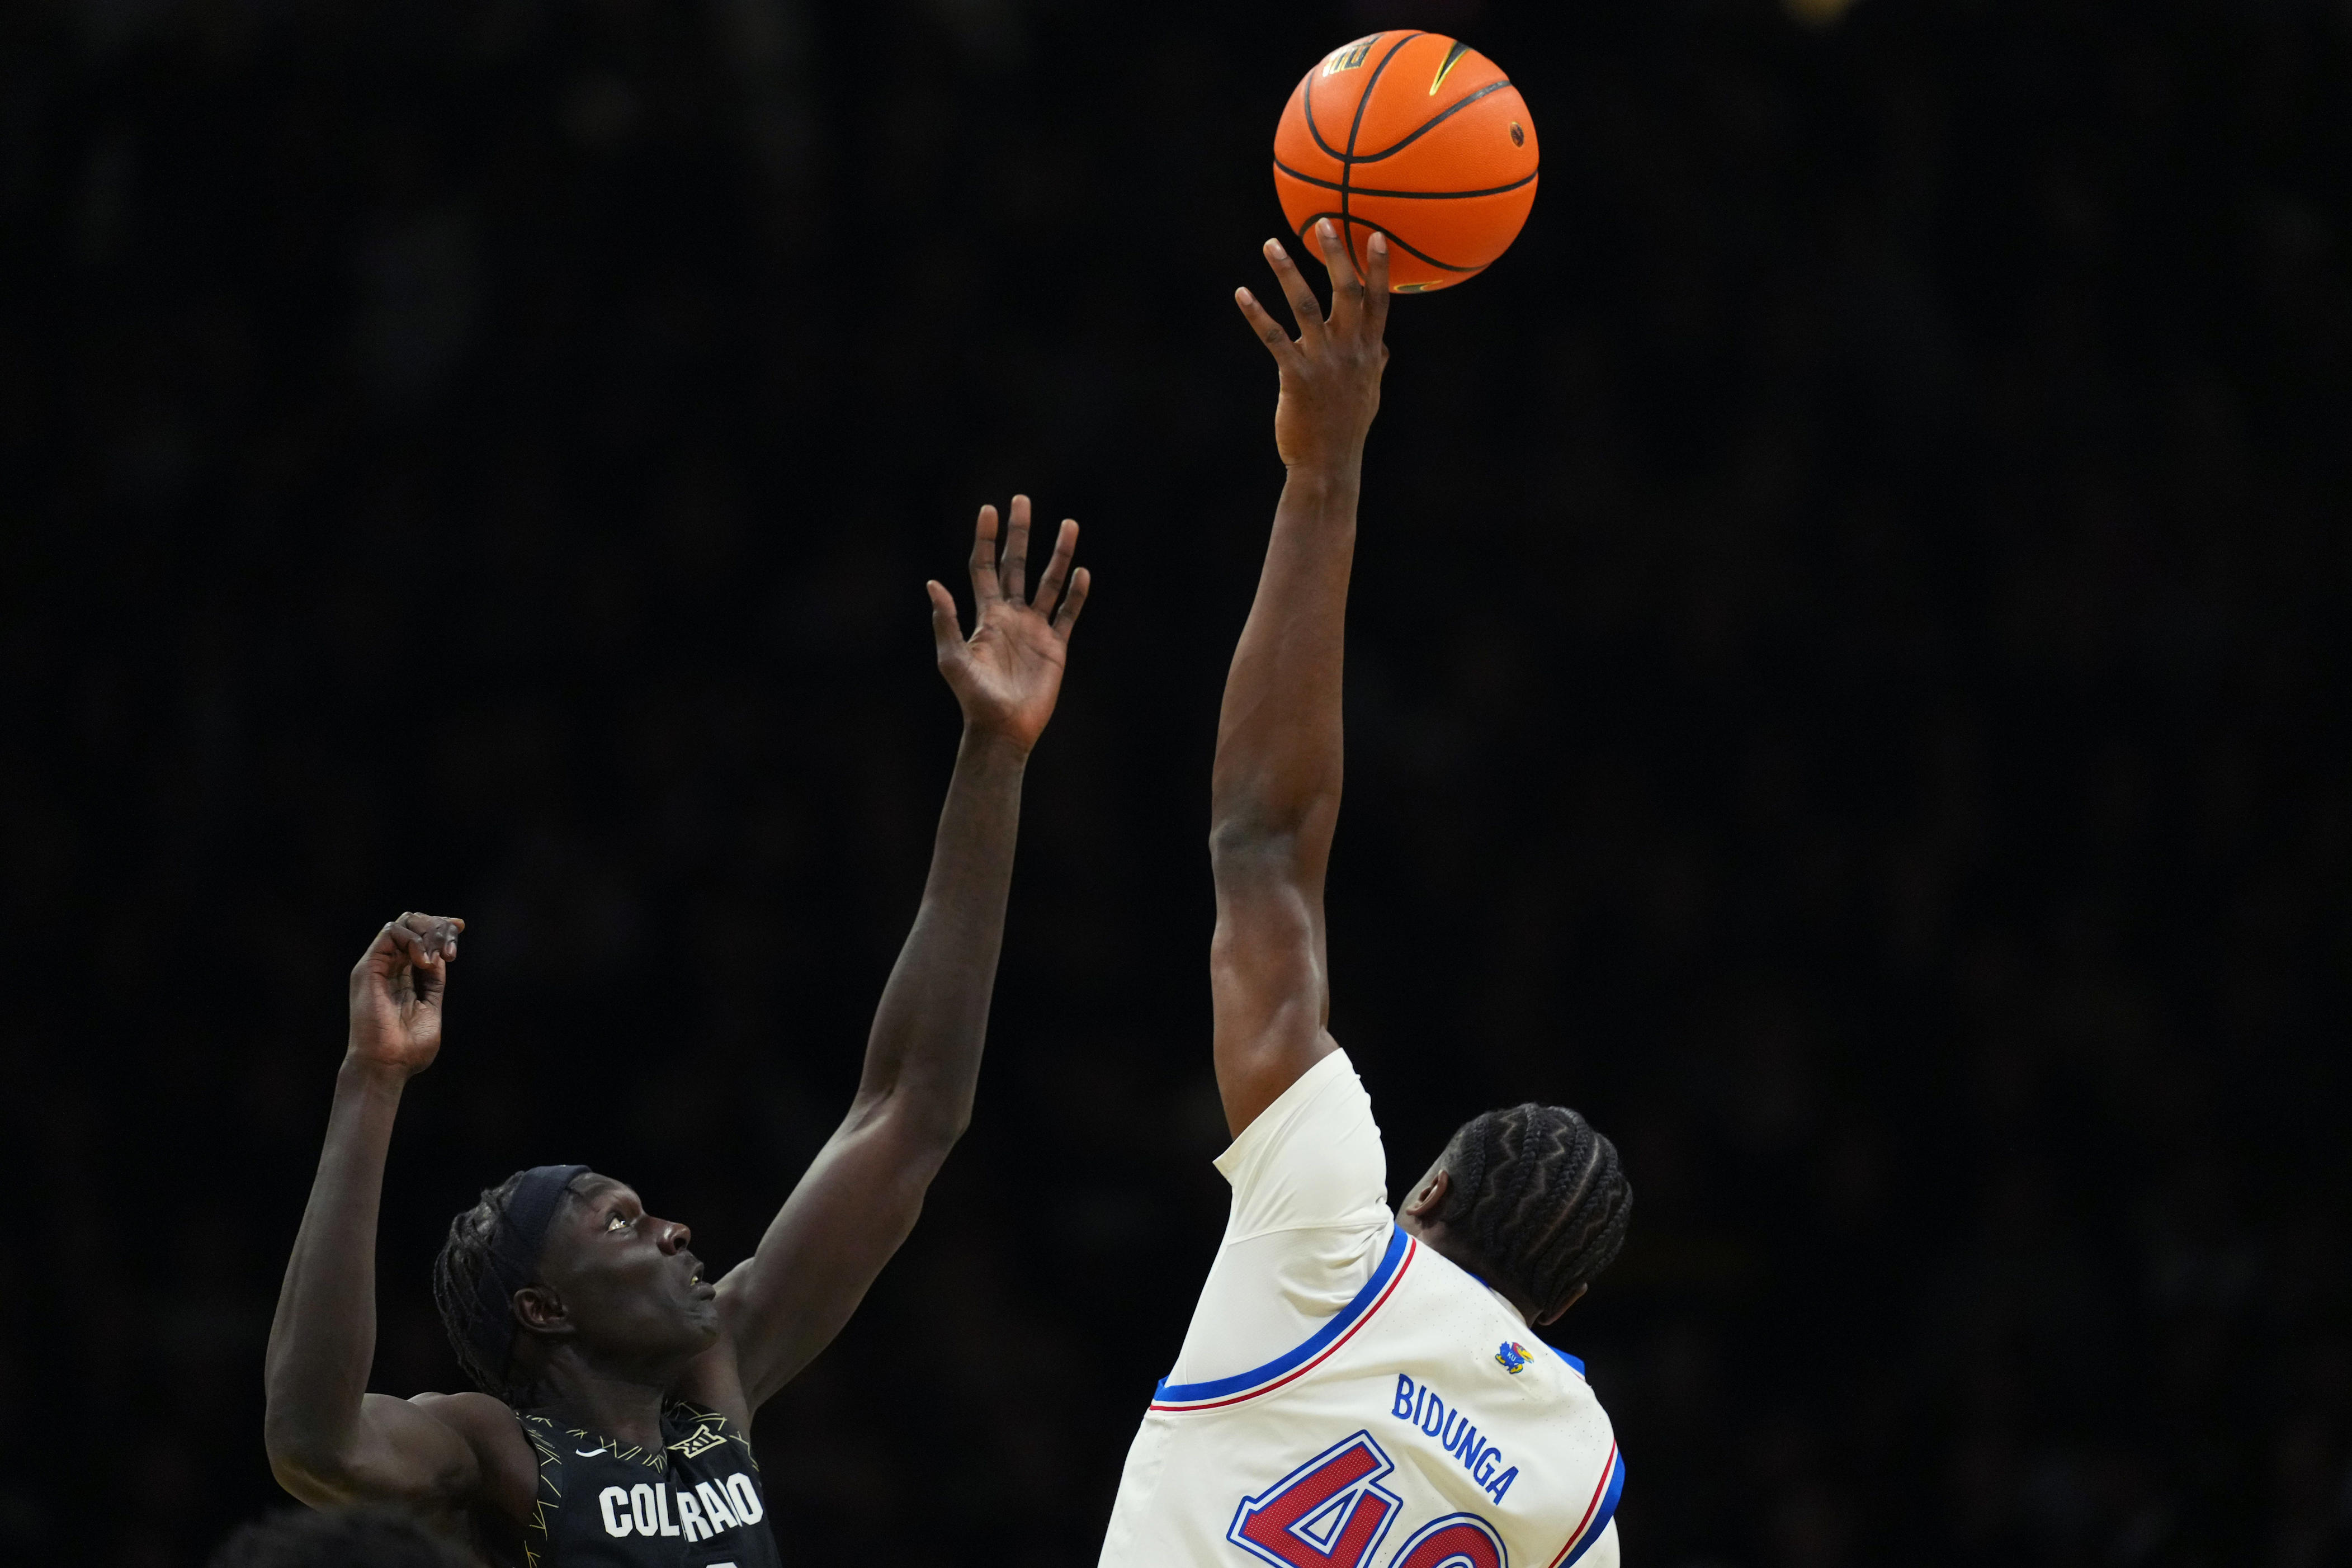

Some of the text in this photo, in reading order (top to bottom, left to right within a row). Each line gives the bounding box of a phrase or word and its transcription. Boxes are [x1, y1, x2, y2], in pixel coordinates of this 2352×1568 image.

[1507, 1351, 1517, 1362] KU
[1391, 1373, 1519, 1505] BIDUNGA
[598, 1472, 763, 1542] COLRAO
